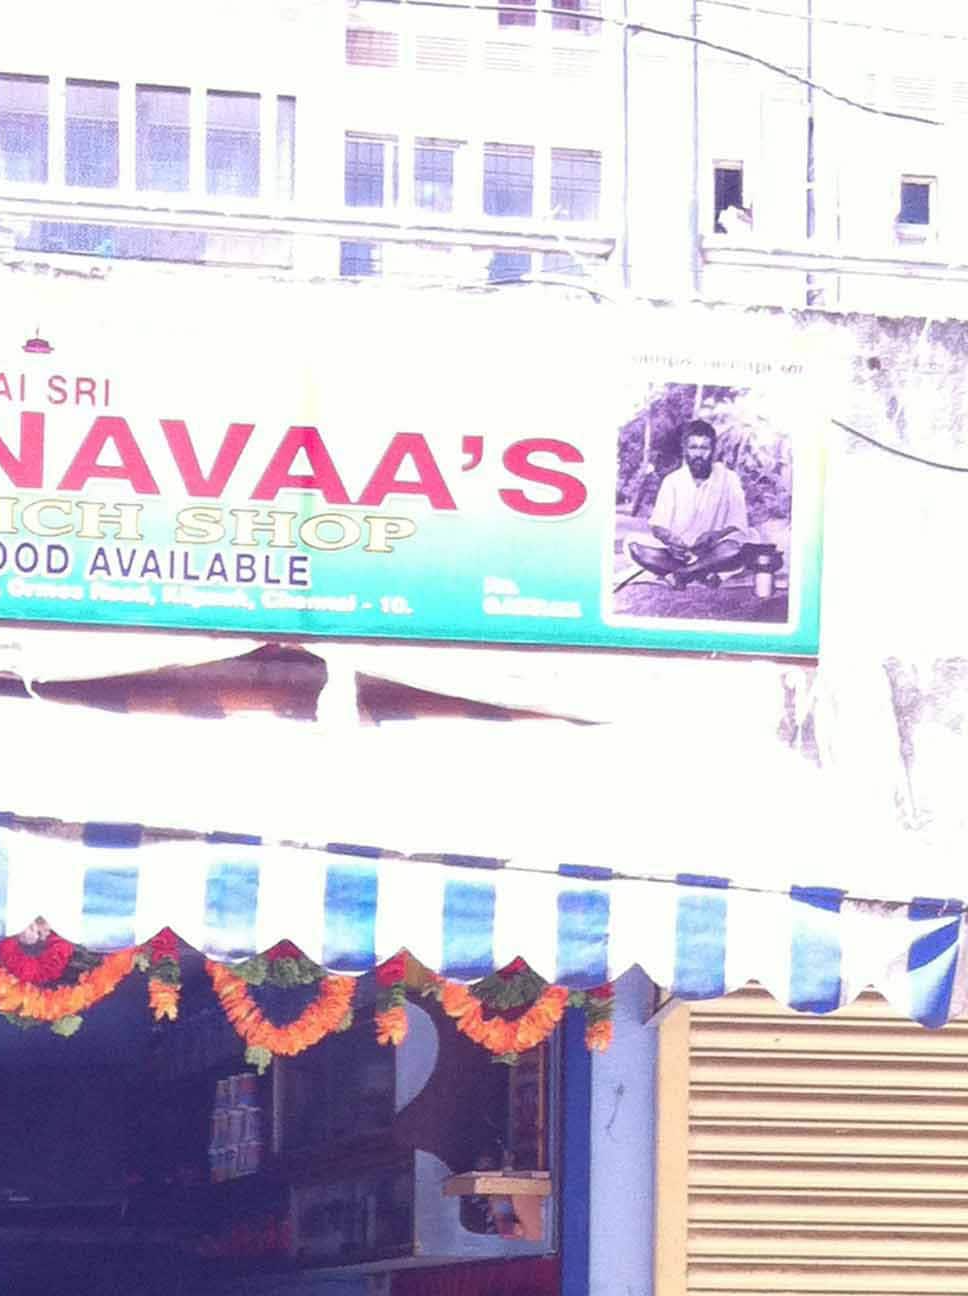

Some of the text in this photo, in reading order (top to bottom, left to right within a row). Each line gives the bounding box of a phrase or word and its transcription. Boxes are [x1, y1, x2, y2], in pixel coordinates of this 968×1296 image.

[47, 375, 111, 407] SRI
[175, 502, 417, 554] SHOP
[88, 546, 309, 586] AVAILABLE
